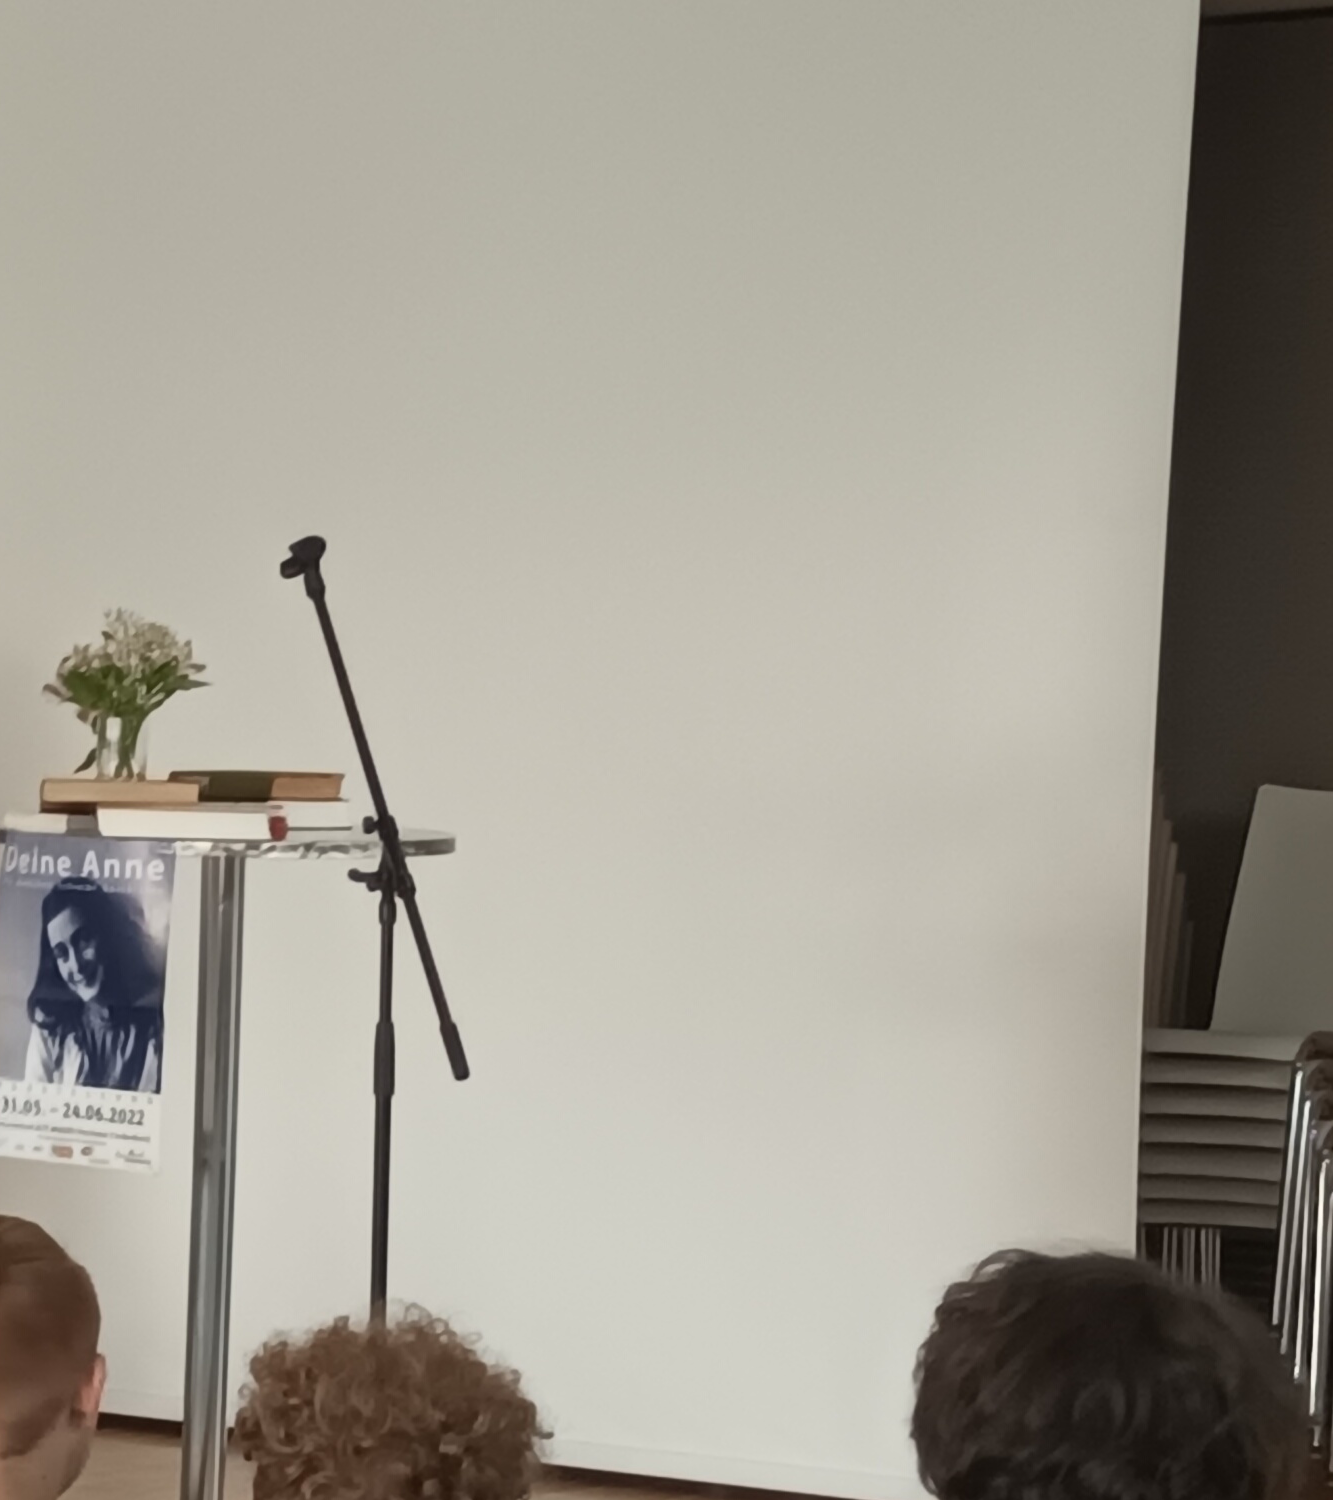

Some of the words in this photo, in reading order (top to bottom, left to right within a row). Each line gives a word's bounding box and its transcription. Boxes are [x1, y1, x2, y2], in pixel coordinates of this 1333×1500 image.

[5, 846, 72, 877] Deine
[81, 850, 165, 881] Anne
[62, 1102, 145, 1126] 24.06.2022
